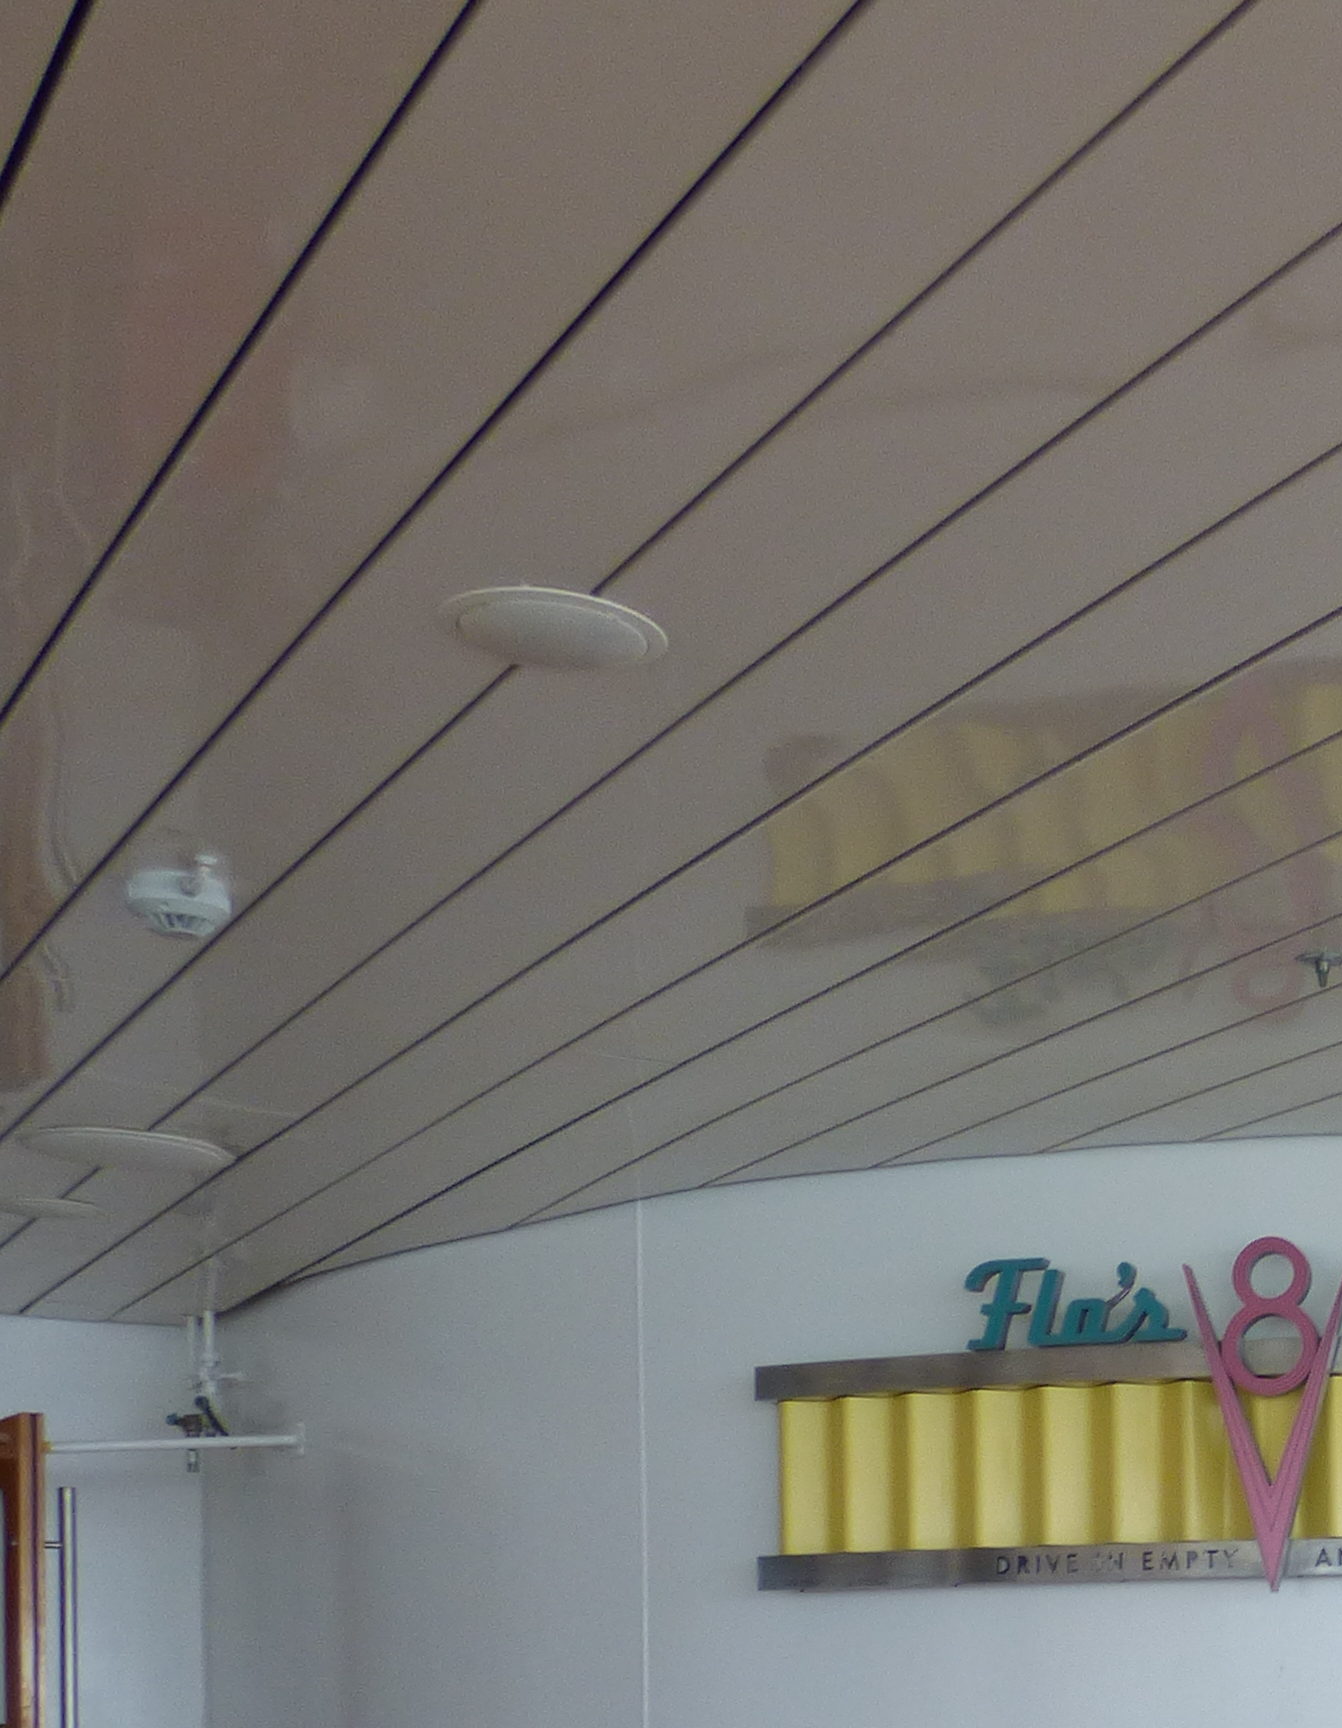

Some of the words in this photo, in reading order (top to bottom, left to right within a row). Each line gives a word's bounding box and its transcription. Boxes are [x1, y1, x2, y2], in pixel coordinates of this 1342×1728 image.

[964, 1257, 1188, 1351] Flo's
[996, 1552, 1079, 1576] DRIVE
[1141, 1548, 1240, 1572] EMPTY
